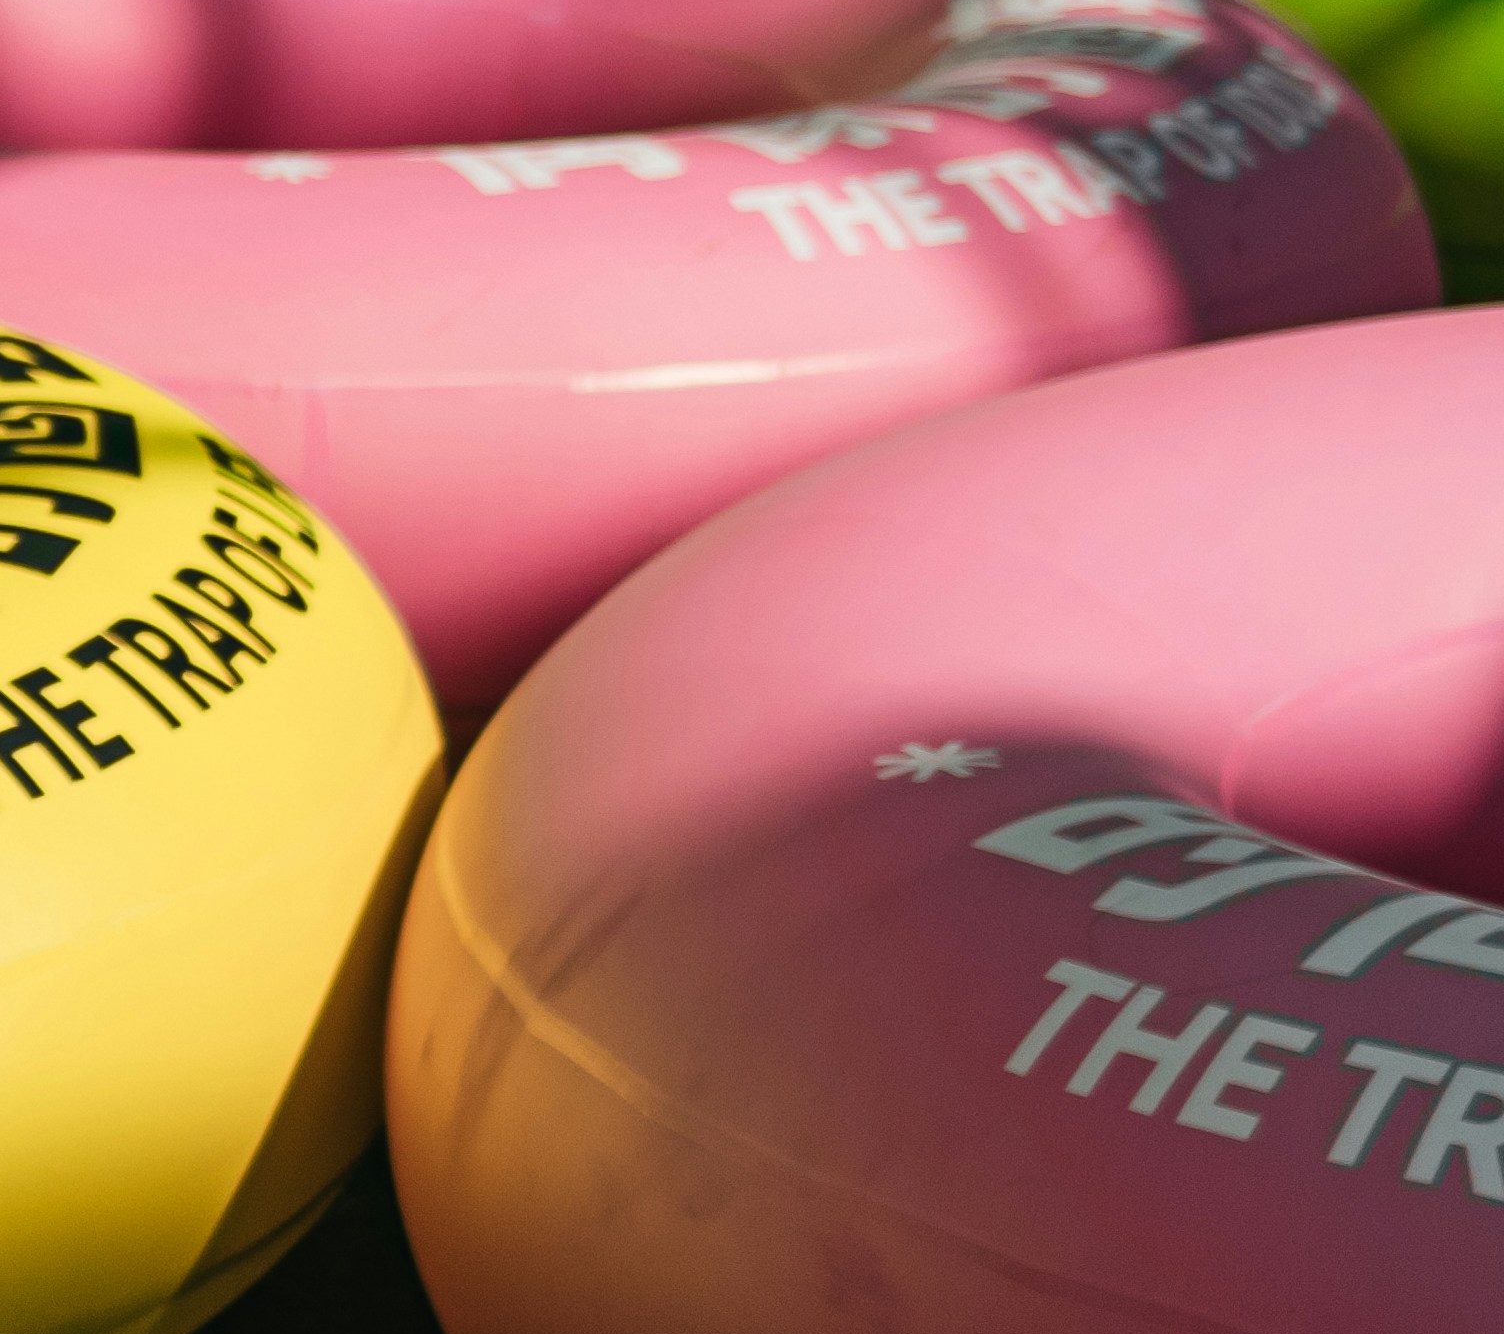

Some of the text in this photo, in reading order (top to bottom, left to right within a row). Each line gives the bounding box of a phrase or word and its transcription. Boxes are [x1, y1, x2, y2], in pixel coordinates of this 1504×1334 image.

[730, 169, 968, 262] THE
[936, 127, 1166, 234] TRAP
[1149, 96, 1257, 182] OF
[65, 566, 277, 731] TRAP
[201, 506, 315, 613] OF
[1004, 957, 1321, 1143] THE
